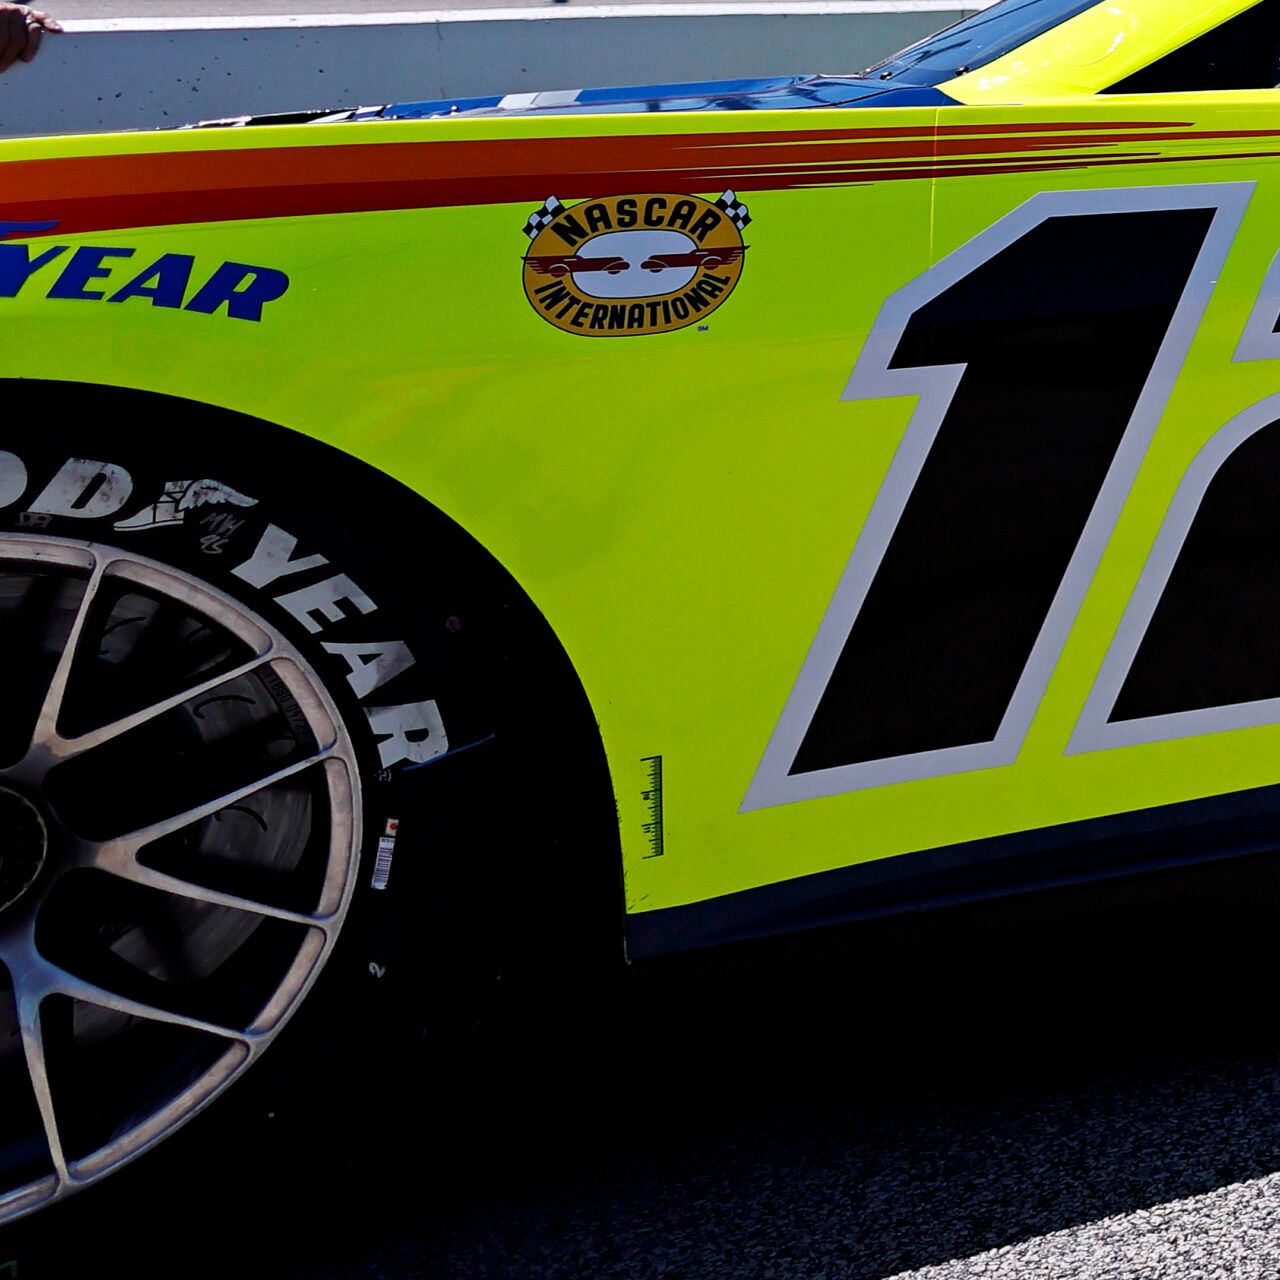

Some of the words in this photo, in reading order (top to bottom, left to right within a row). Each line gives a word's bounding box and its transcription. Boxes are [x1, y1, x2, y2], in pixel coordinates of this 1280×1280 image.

[551, 197, 722, 247] NASCAR
[534, 273, 731, 330] INTERNATIONAL
[229, 522, 450, 770] YEAR
